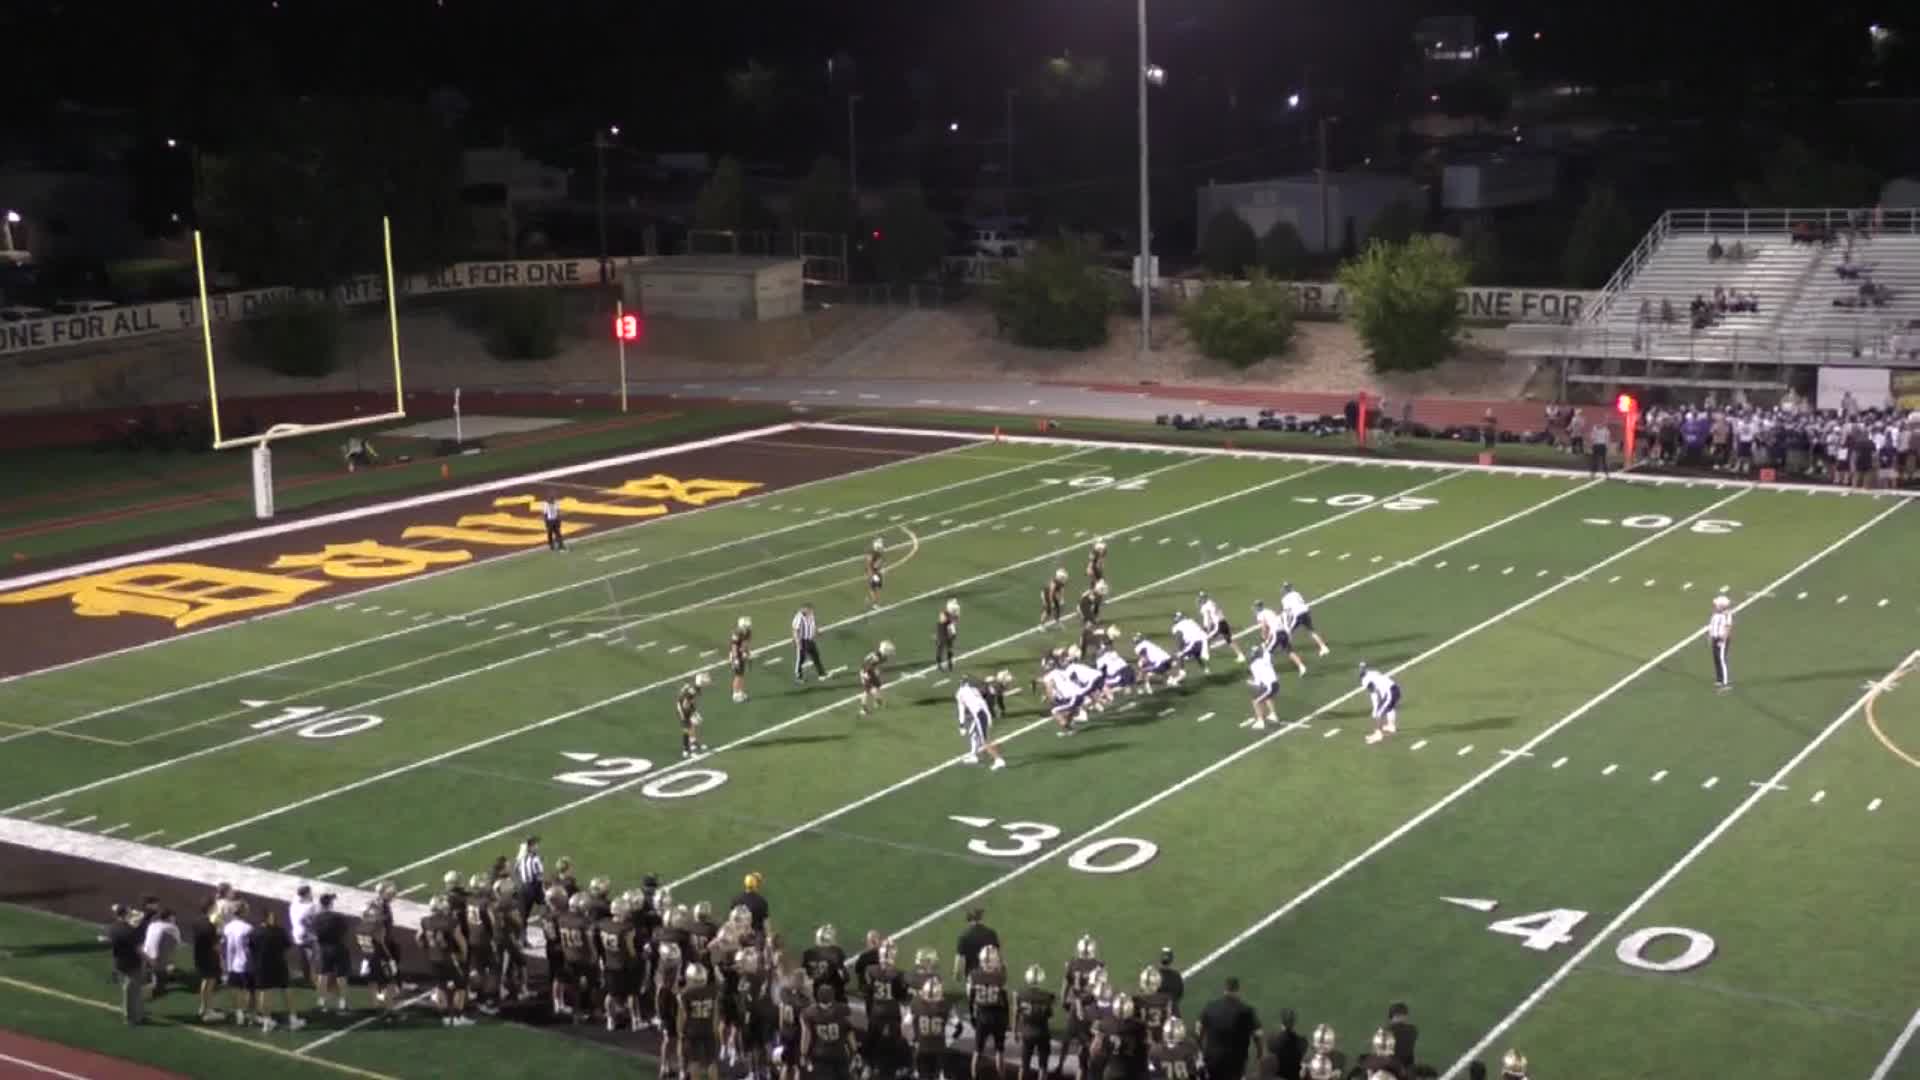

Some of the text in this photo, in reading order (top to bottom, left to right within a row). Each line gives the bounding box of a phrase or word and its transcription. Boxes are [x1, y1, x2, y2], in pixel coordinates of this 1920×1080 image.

[427, 264, 462, 288] ALL
[469, 263, 518, 284] FOR
[527, 262, 580, 281] ONE
[1521, 292, 1584, 318] FOR
[53, 316, 104, 342] FOR
[113, 308, 160, 334] ALL
[616, 316, 637, 339] 13
[551, 756, 729, 799] 20
[966, 821, 1160, 874] 30
[1486, 908, 1720, 973] 40
[874, 981, 893, 1000] 31
[1139, 1007, 1162, 1027] 13
